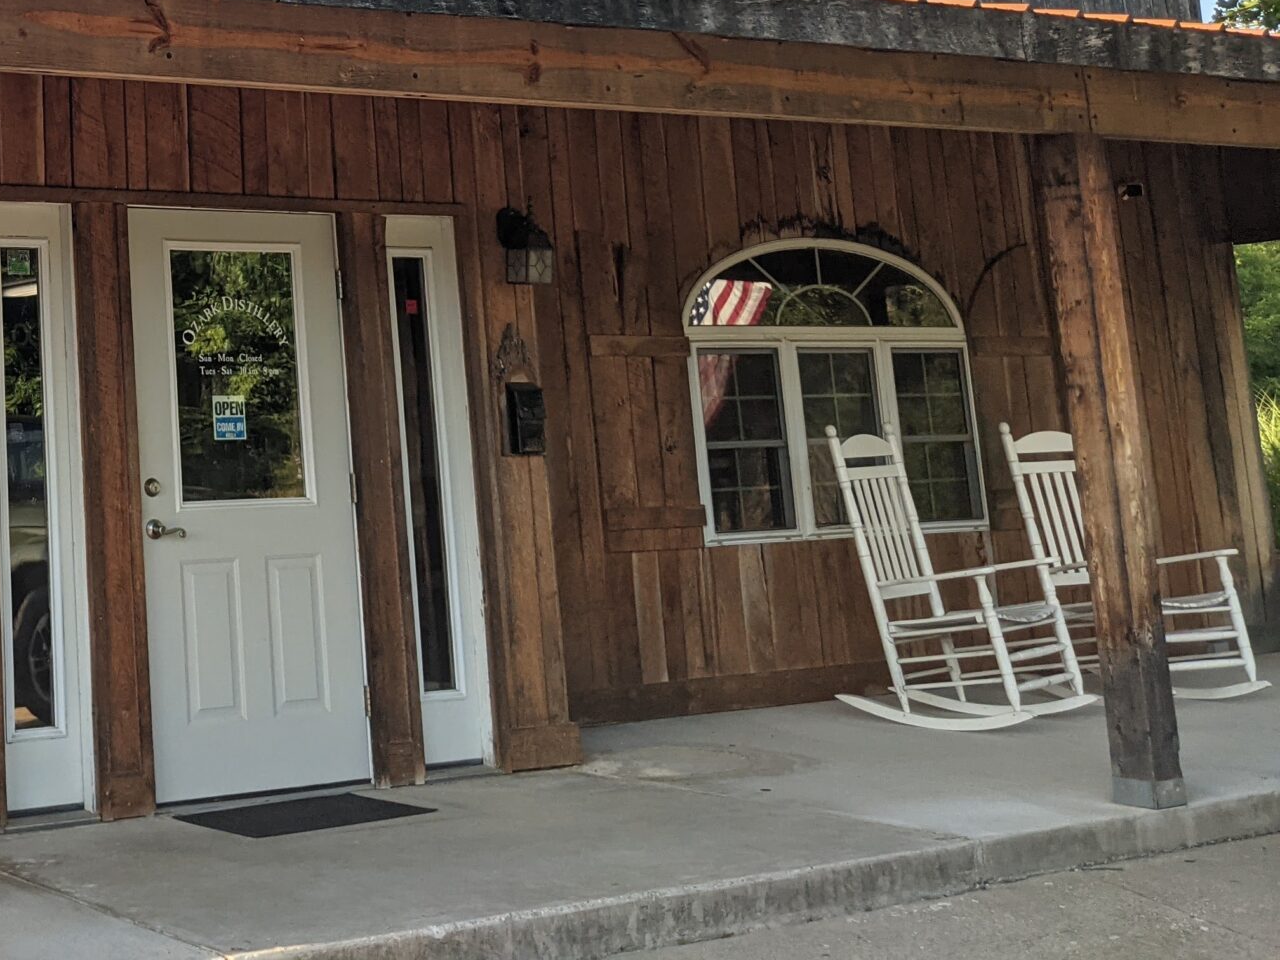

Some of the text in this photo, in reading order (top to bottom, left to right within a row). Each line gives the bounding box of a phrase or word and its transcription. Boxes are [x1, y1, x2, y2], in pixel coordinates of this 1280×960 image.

[182, 295, 289, 346] OZARK DISTILLERY
[218, 353, 234, 362] Mon
[239, 353, 263, 362] Closed
[221, 366, 233, 375] Sat
[214, 401, 244, 416] OPEN
[216, 422, 236, 432] COME
